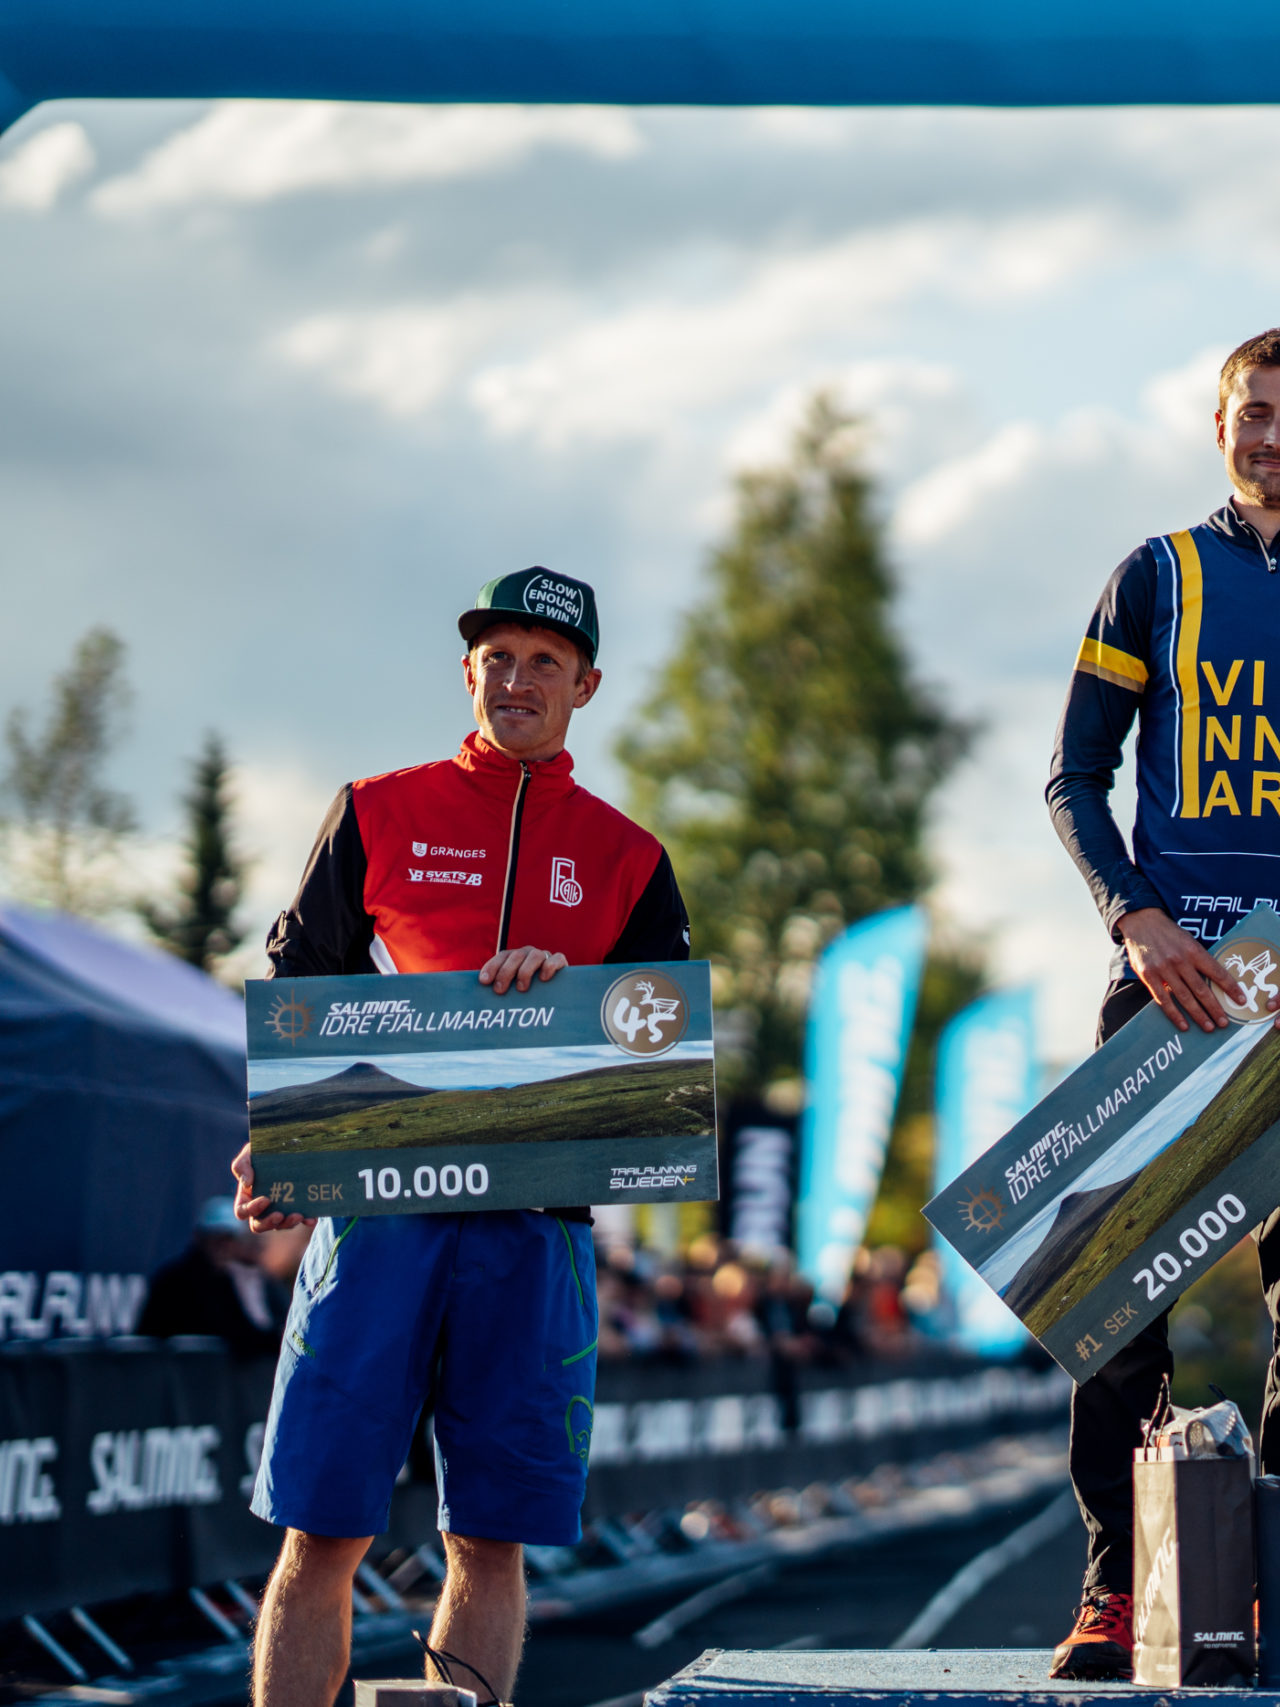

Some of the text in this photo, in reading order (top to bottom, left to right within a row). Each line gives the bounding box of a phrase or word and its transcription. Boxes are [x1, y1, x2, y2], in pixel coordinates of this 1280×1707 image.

[540, 579, 577, 600] SLOW
[528, 589, 579, 618] ENOUGH
[546, 605, 569, 623] WIN
[1200, 659, 1265, 707] VI
[430, 846, 487, 859] GRÄNGES
[425, 871, 467, 880] SVETS
[465, 873, 483, 886] AB
[319, 1014, 375, 1036] IDRE
[610, 1165, 697, 1176] TRAILRUNNING
[1008, 1154, 1052, 1205] IDRE
[269, 1163, 489, 1203] #2 SEK 10.000
[1075, 1193, 1246, 1361] #1 SEK 20.000
